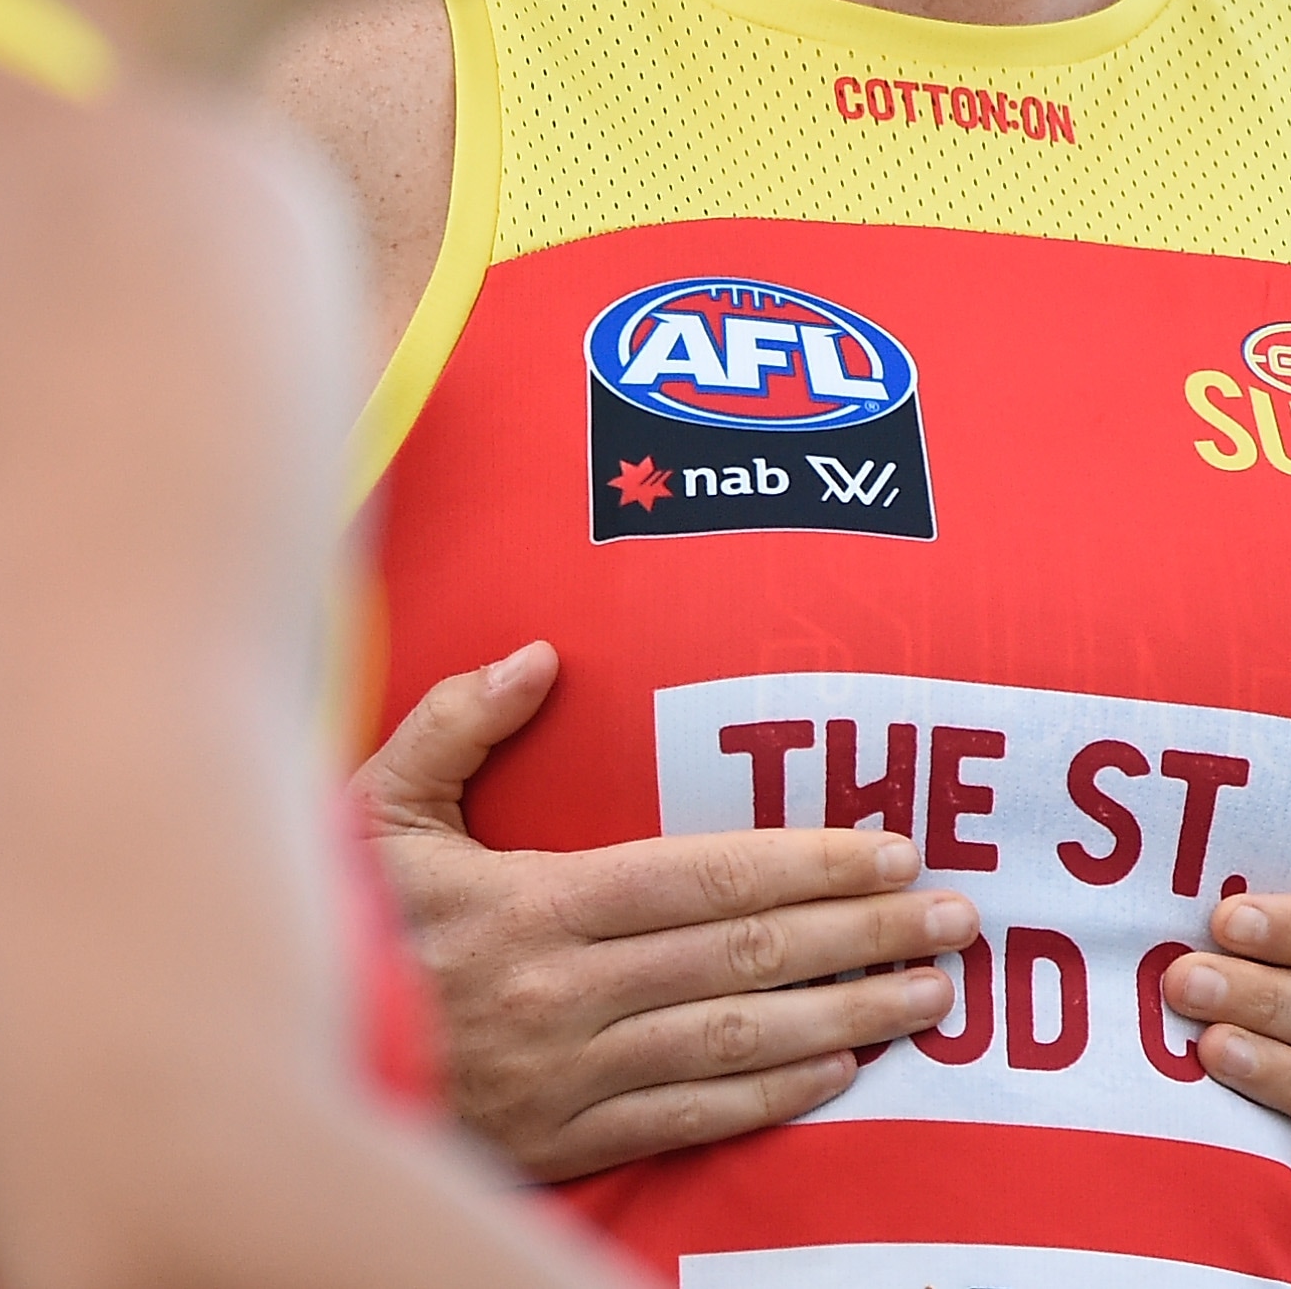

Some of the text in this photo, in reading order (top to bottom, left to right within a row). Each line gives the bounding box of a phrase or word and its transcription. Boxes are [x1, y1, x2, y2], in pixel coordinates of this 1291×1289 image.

[833, 76, 1076, 145] COTTON:ON
[619, 312, 890, 401] AFL
[682, 457, 791, 498] nab
[718, 719, 1006, 872] THE
